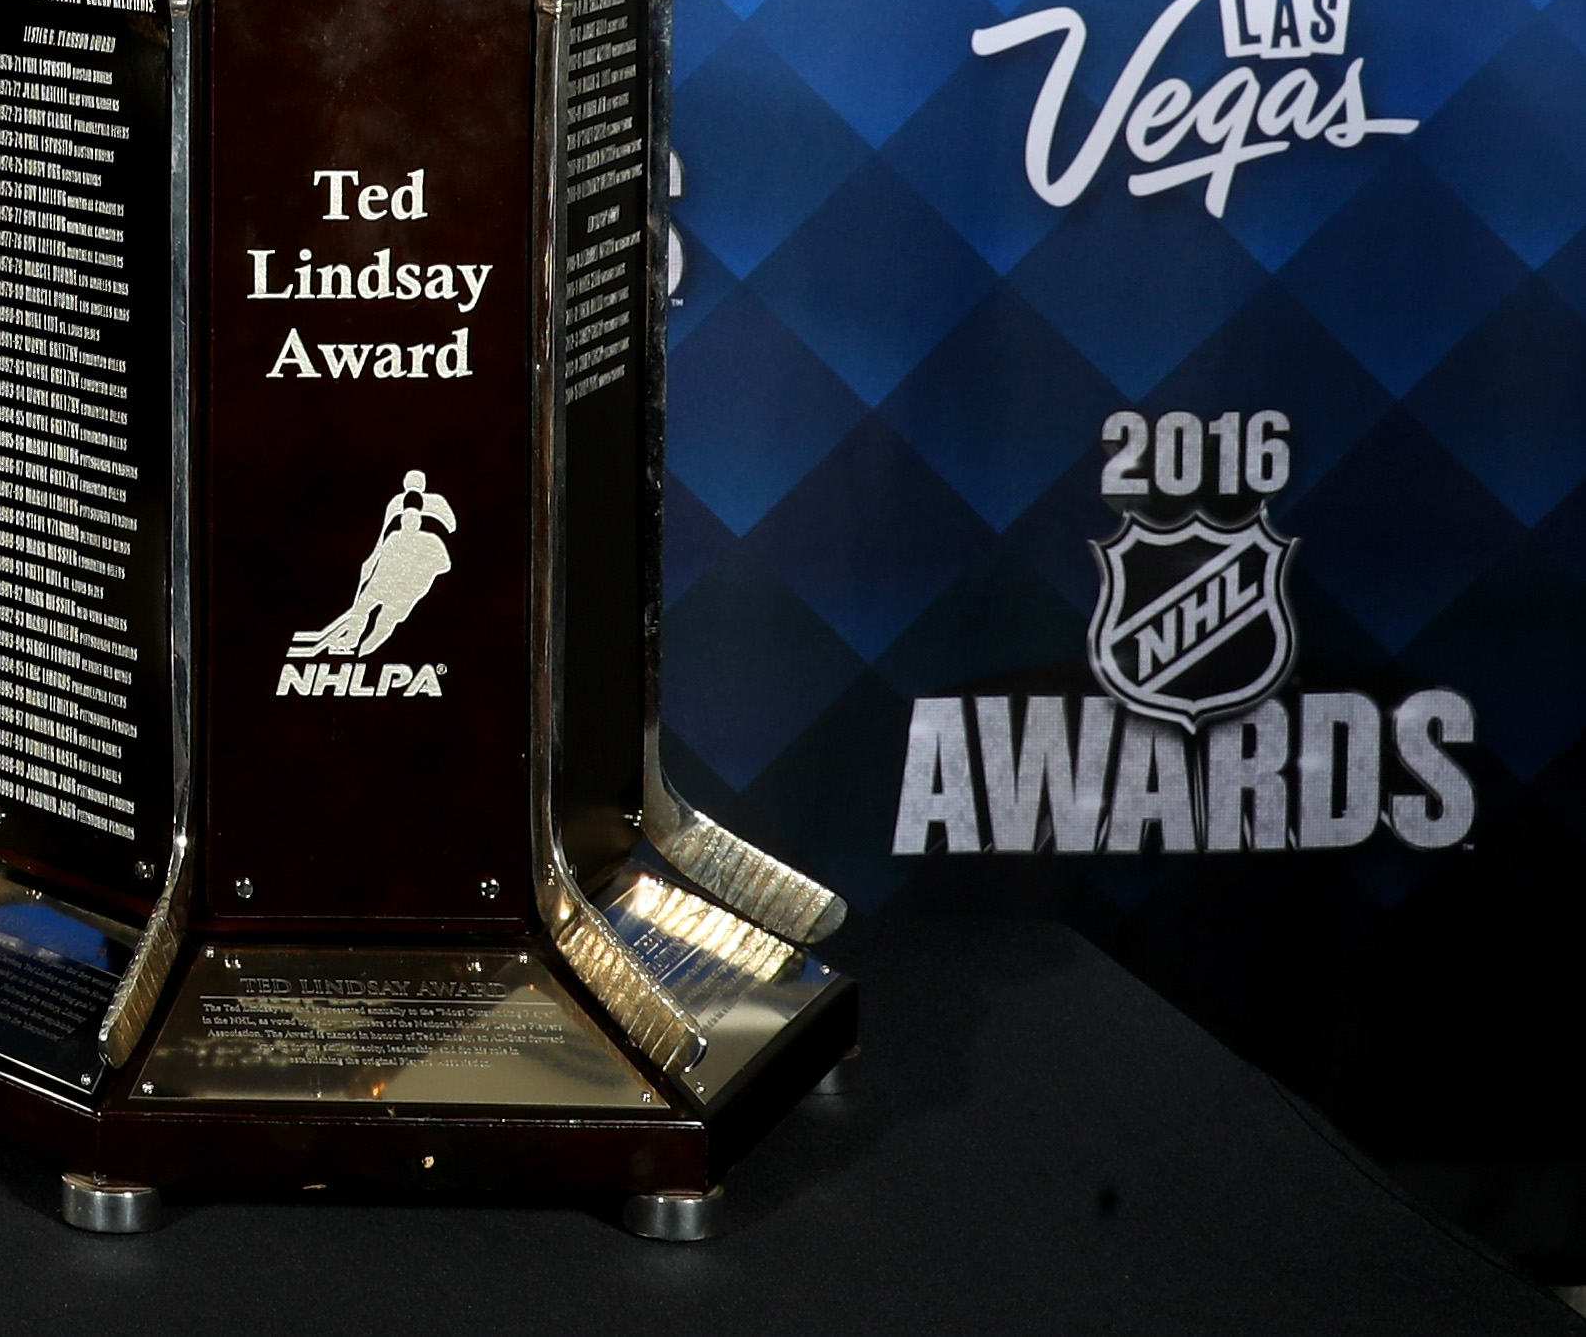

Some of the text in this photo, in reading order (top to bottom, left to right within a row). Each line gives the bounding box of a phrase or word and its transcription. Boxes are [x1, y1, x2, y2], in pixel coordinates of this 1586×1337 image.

[313, 169, 428, 220] Ted
[247, 248, 493, 313] Lindsay
[266, 327, 473, 379] Award
[1100, 409, 1290, 496] 2016
[1133, 561, 1258, 681] NHL
[276, 663, 442, 697] NHLPA
[891, 689, 1475, 855] AWARDS
[239, 977, 507, 997] TED LINDSAY AWARD
